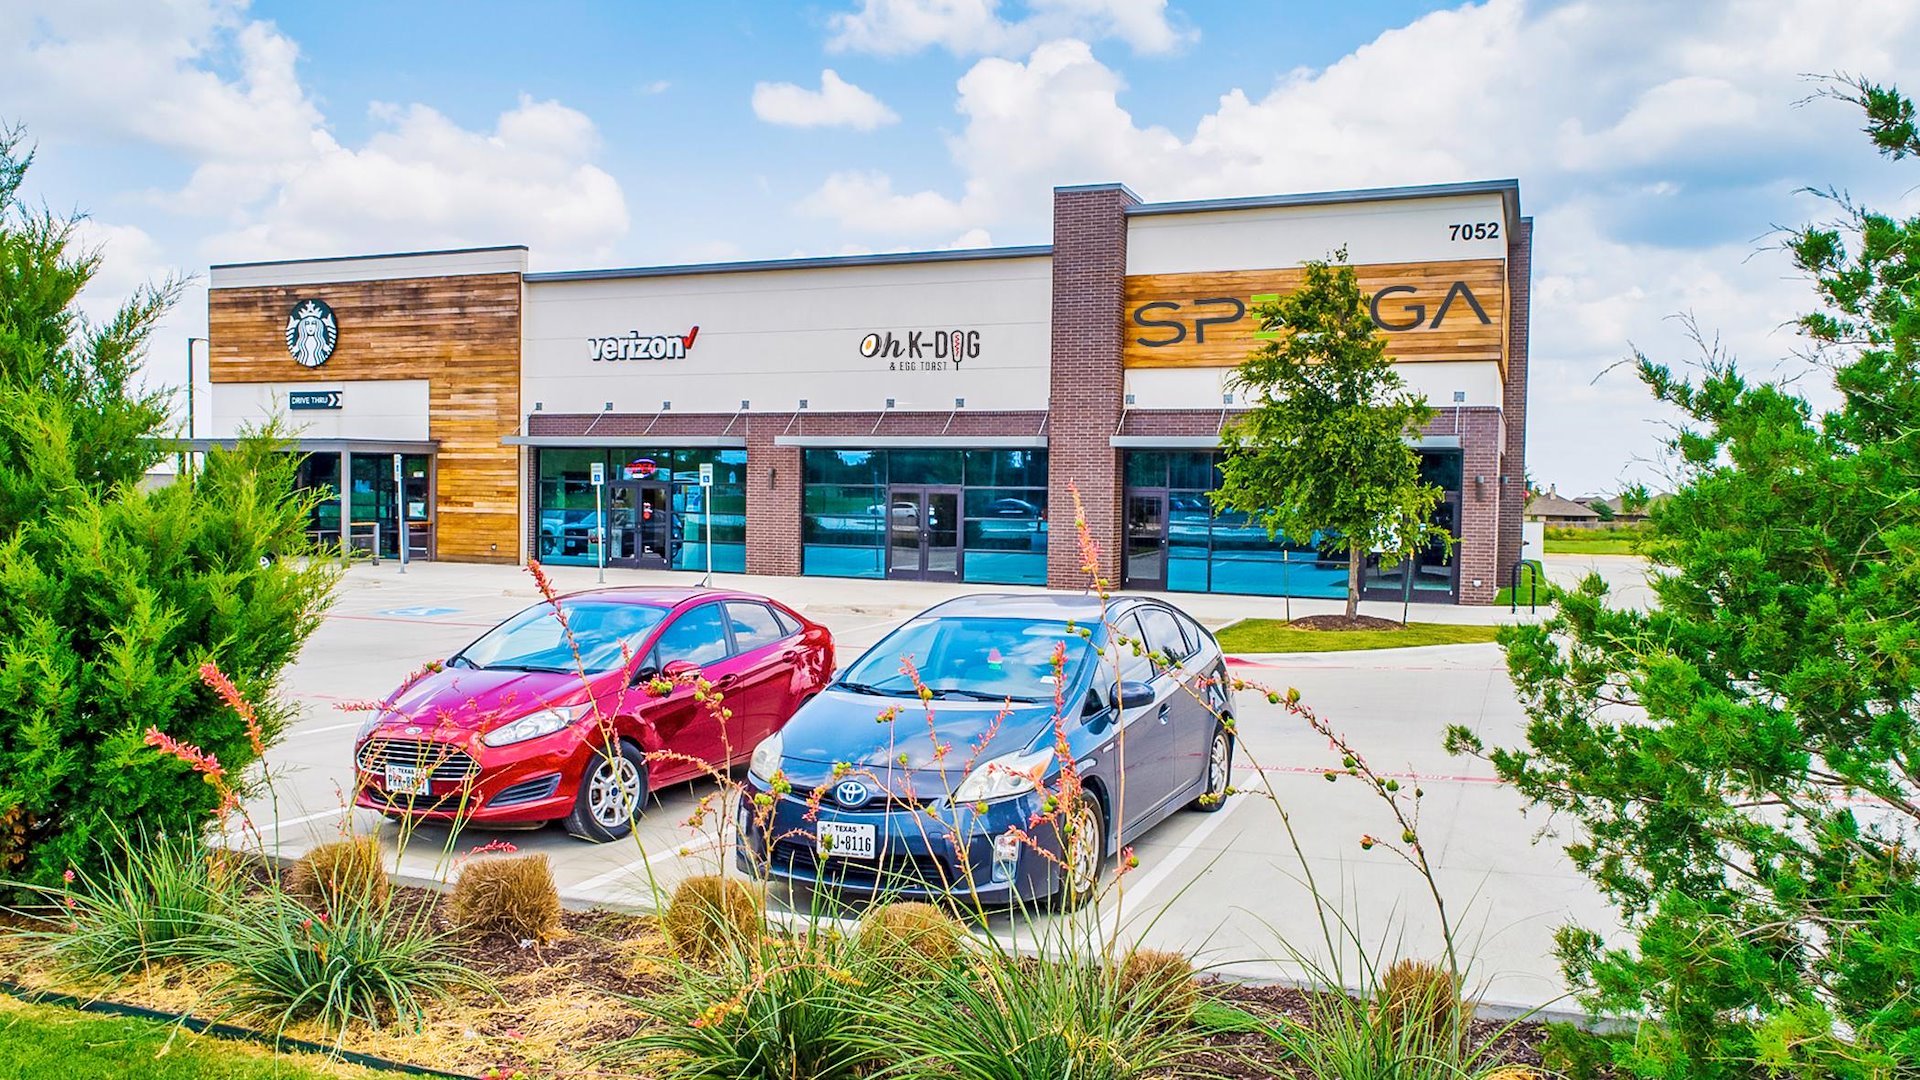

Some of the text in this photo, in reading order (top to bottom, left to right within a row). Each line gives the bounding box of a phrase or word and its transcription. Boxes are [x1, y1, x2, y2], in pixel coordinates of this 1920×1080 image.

[1449, 222, 1499, 241] 7052
[1133, 280, 1492, 348] SPEGA
[587, 330, 686, 361] verizon
[860, 331, 905, 358] Oh
[889, 361, 947, 371] & EGG TOAST
[291, 396, 328, 405] DRIVE THRU
[398, 767, 414, 775] TEXAS
[835, 825, 857, 833] TEXAS
